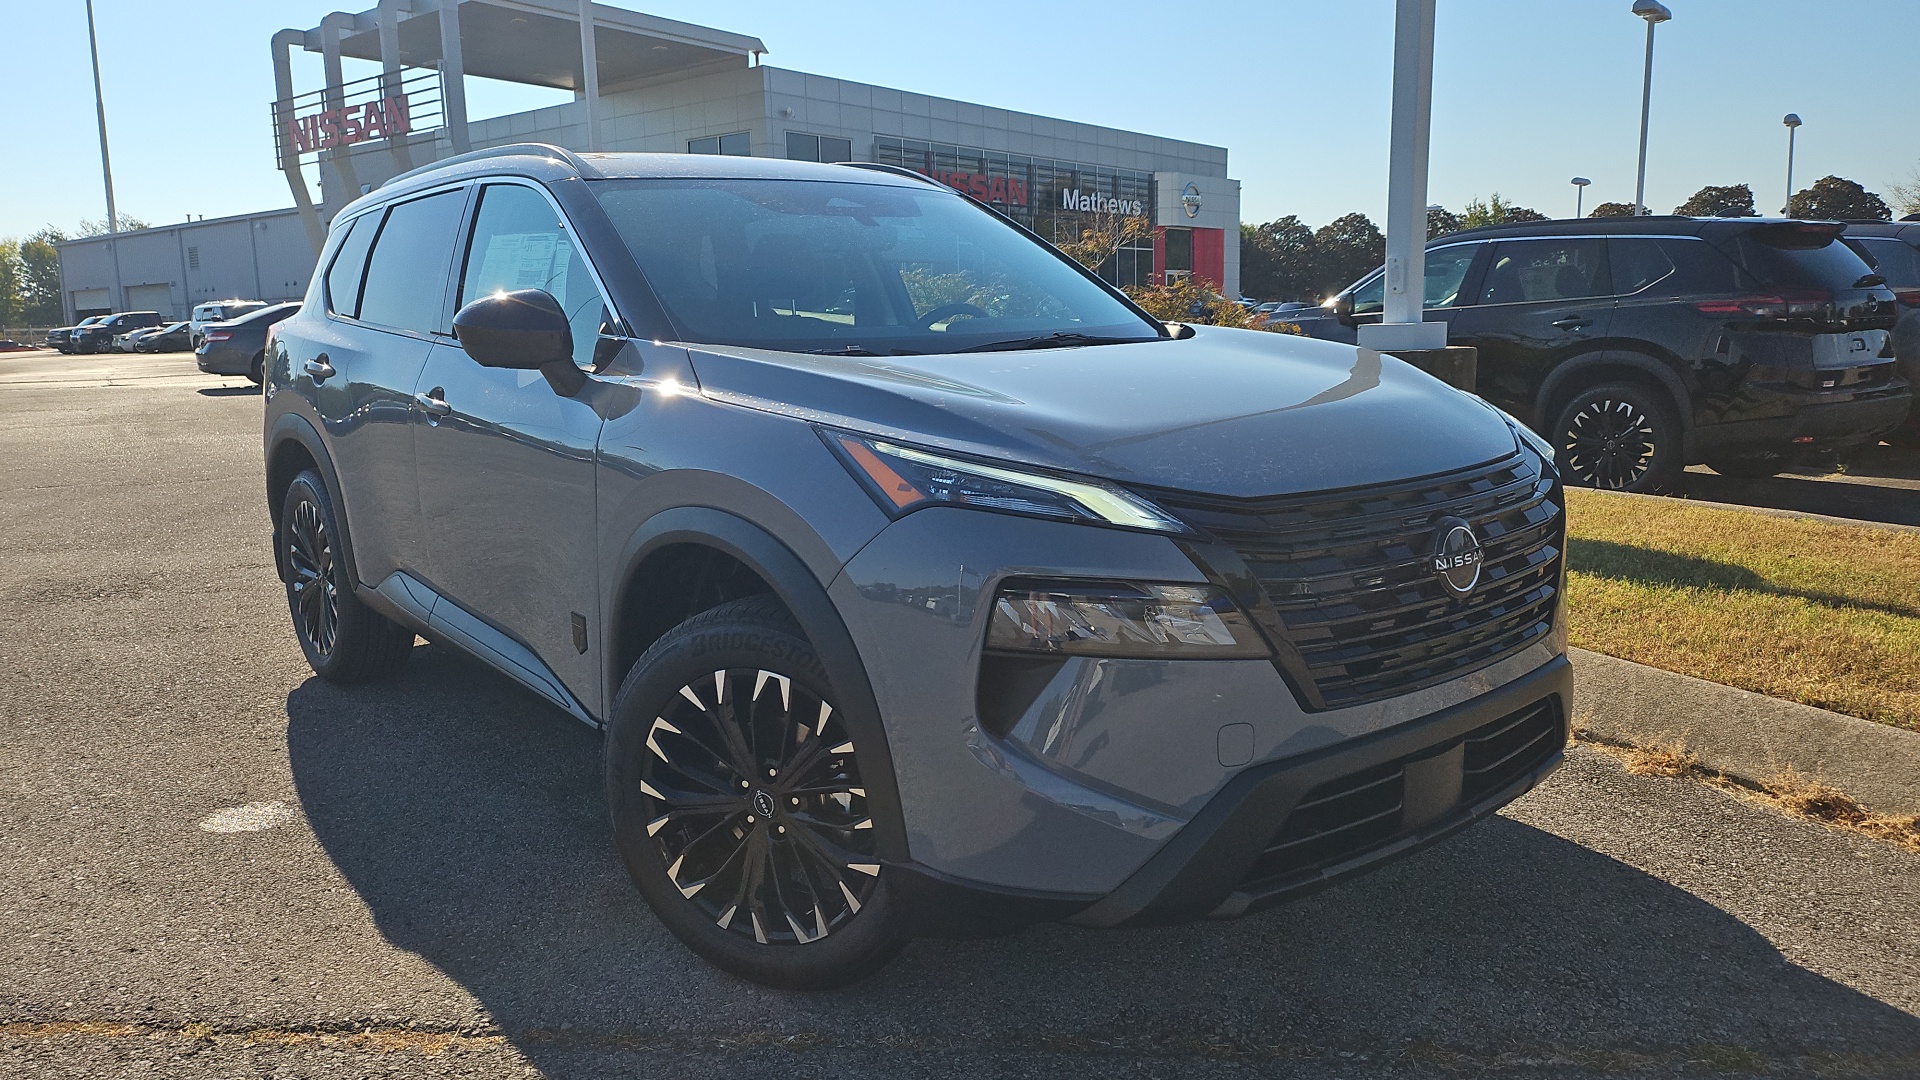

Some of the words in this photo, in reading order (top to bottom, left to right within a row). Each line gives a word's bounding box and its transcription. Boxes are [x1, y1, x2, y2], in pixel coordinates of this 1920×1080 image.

[287, 94, 410, 153] NISSAN
[918, 168, 1028, 206] ISSAN
[1063, 188, 1142, 216] Mathews
[1435, 549, 1485, 570] NISSAN
[691, 631, 831, 687] BRIDGESTON
